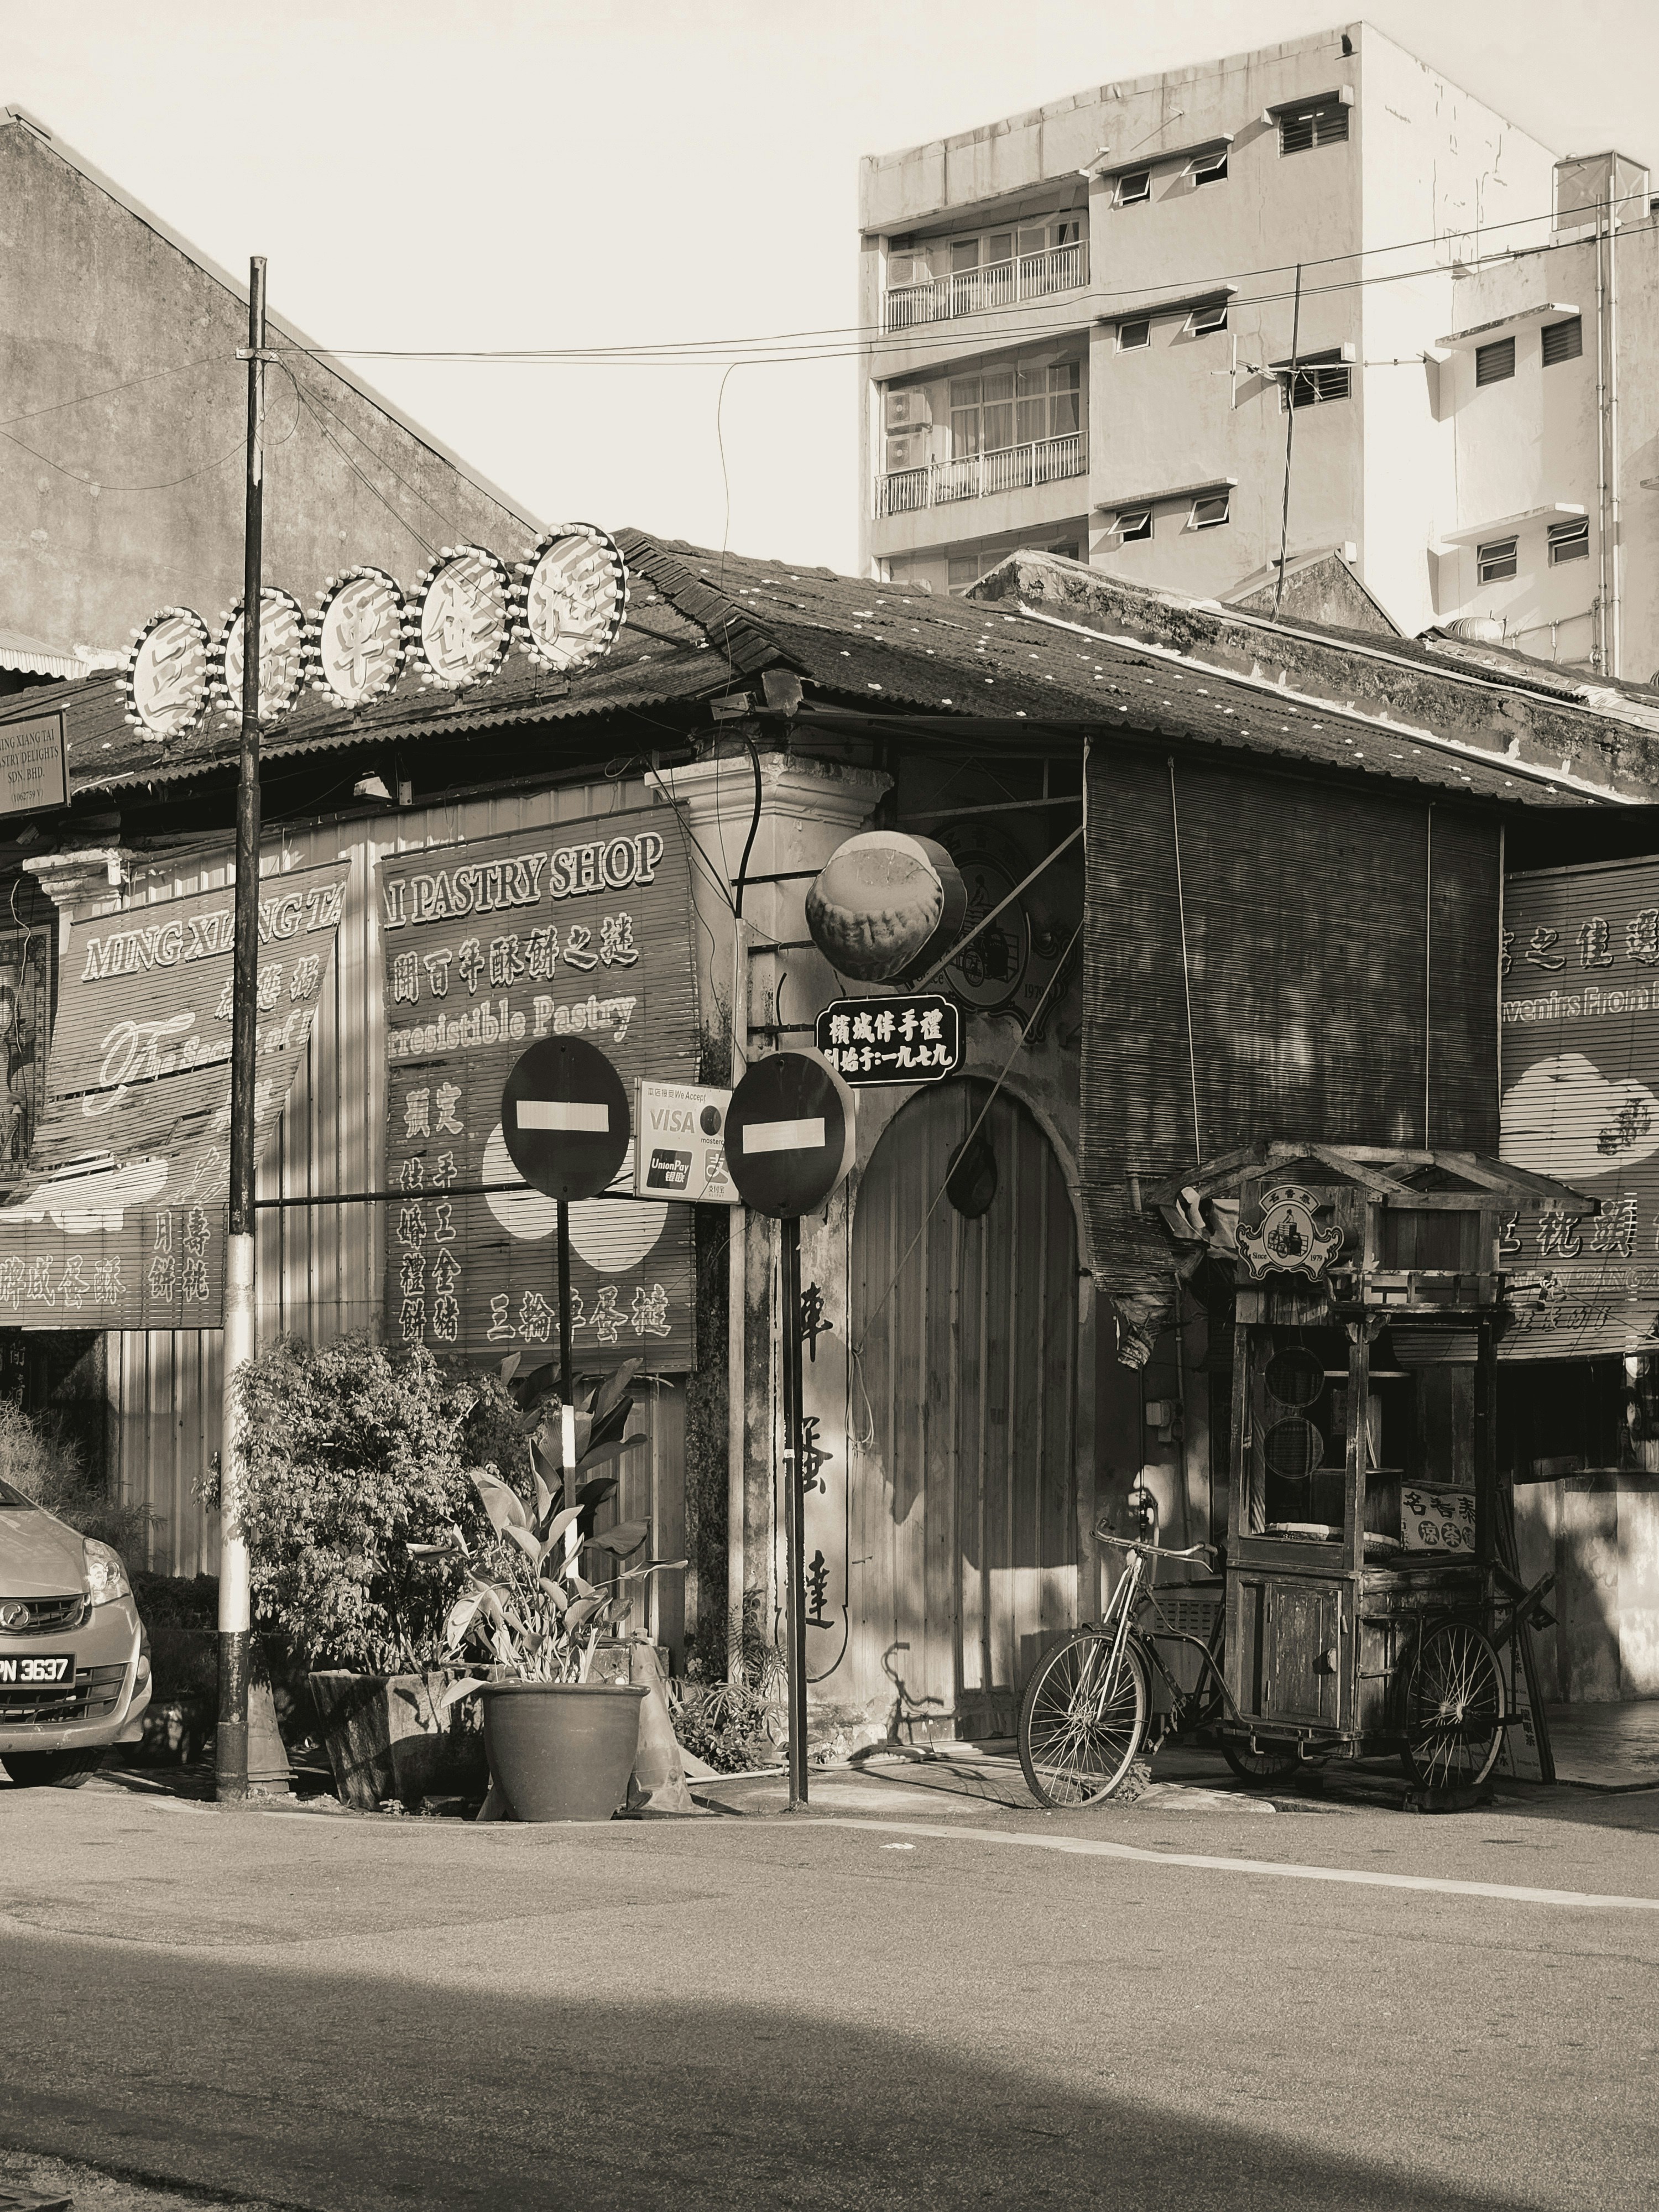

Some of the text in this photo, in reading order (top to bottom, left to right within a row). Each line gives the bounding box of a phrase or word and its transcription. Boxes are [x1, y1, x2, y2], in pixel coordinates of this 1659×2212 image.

[0, 728, 54, 752] ING XIANG TAI
[22, 746, 59, 764] DELIGHTS
[8, 766, 45, 784] SDN. BHD.
[411, 852, 547, 924] PASTRY
[550, 831, 663, 899] SHOP
[81, 920, 183, 982] MING
[184, 892, 303, 963] XING
[1584, 987, 1649, 1016] From
[533, 995, 637, 1042] Pastry
[830, 1009, 943, 1045] 檳城伴手禮
[675, 1090, 684, 1099] We
[650, 1109, 695, 1134] VISA
[651, 1158, 689, 1174] UnionPay
[20, 1658, 69, 1680] 3637
